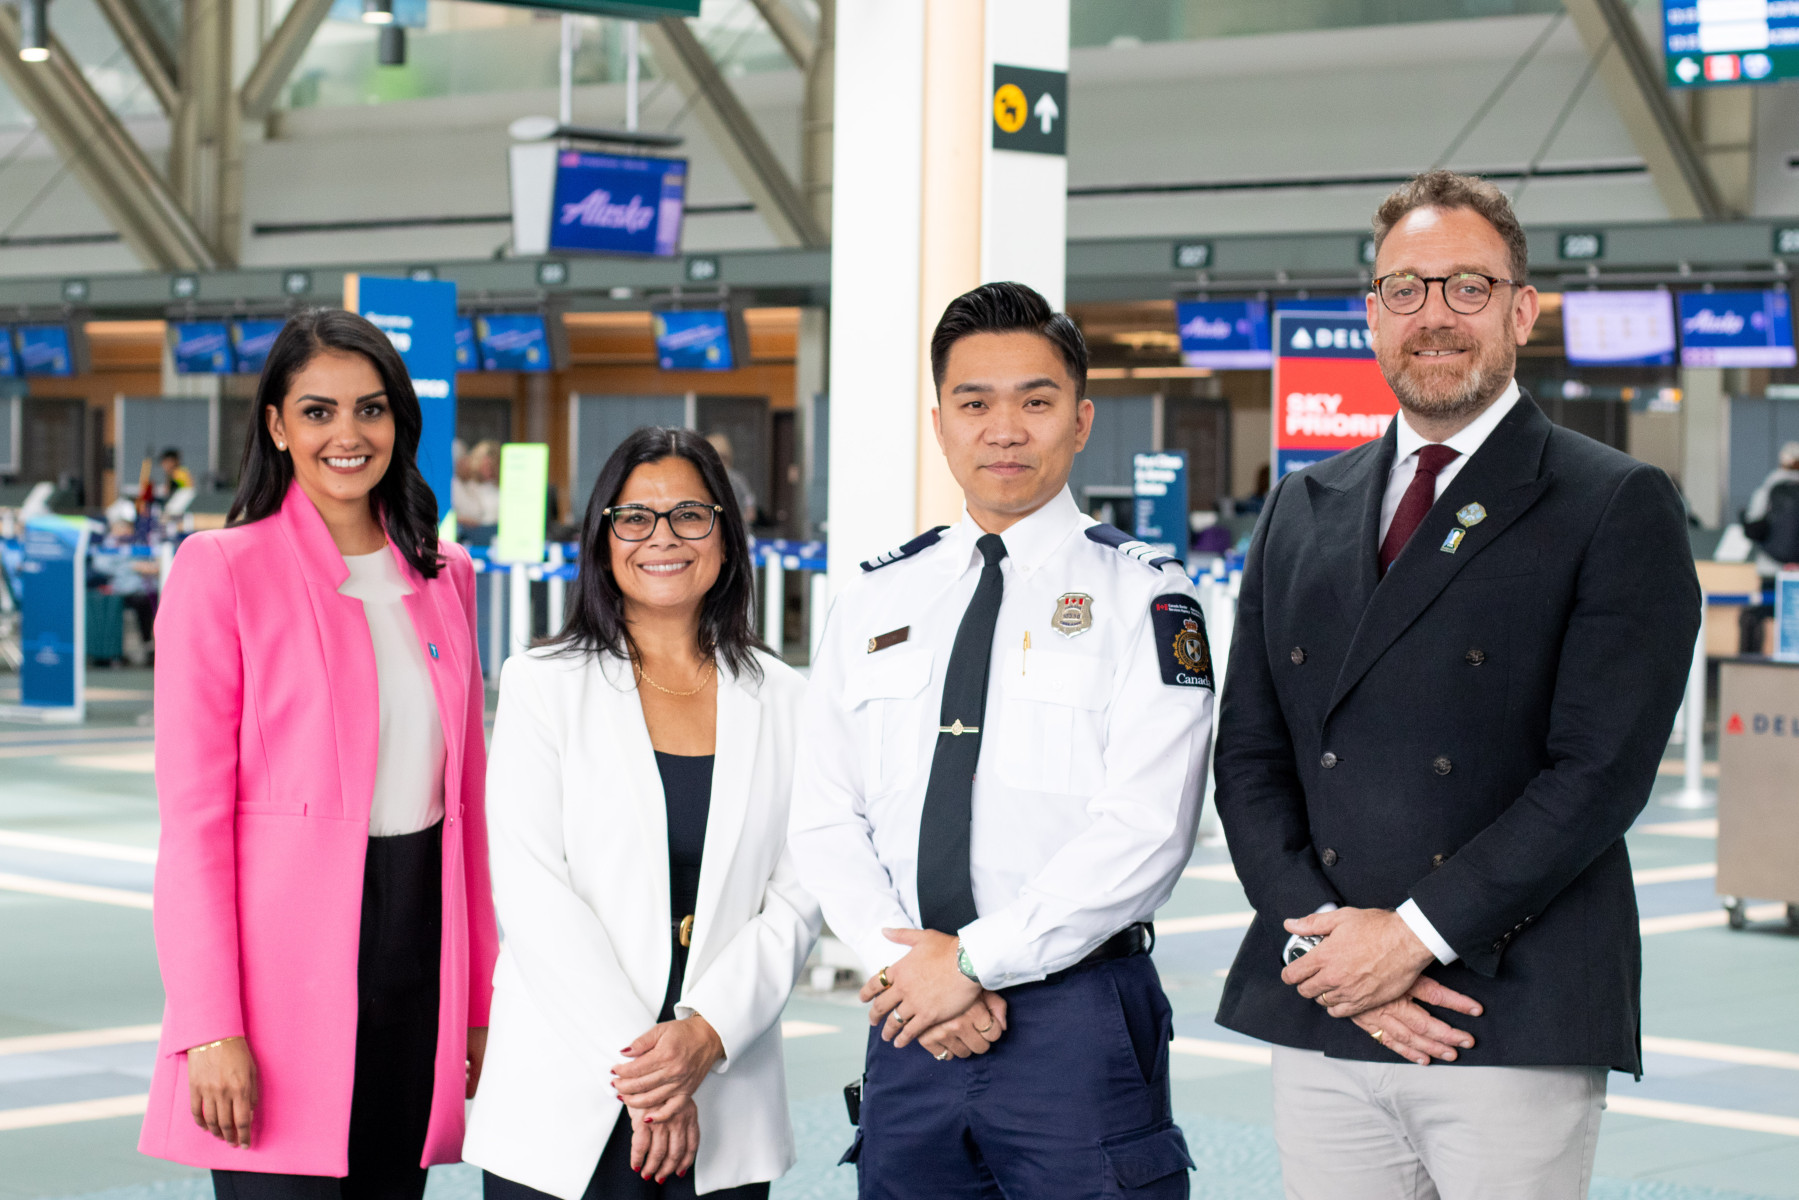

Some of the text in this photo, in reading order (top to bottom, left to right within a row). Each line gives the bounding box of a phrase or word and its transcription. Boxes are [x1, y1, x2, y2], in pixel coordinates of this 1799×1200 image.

[560, 188, 654, 234] Alaska
[1315, 327, 1373, 349] DELT
[1286, 392, 1342, 413] SKY
[1286, 413, 1393, 437] PRIORIT
[1176, 672, 1211, 687] Canada
[1753, 713, 1799, 738] DEL
